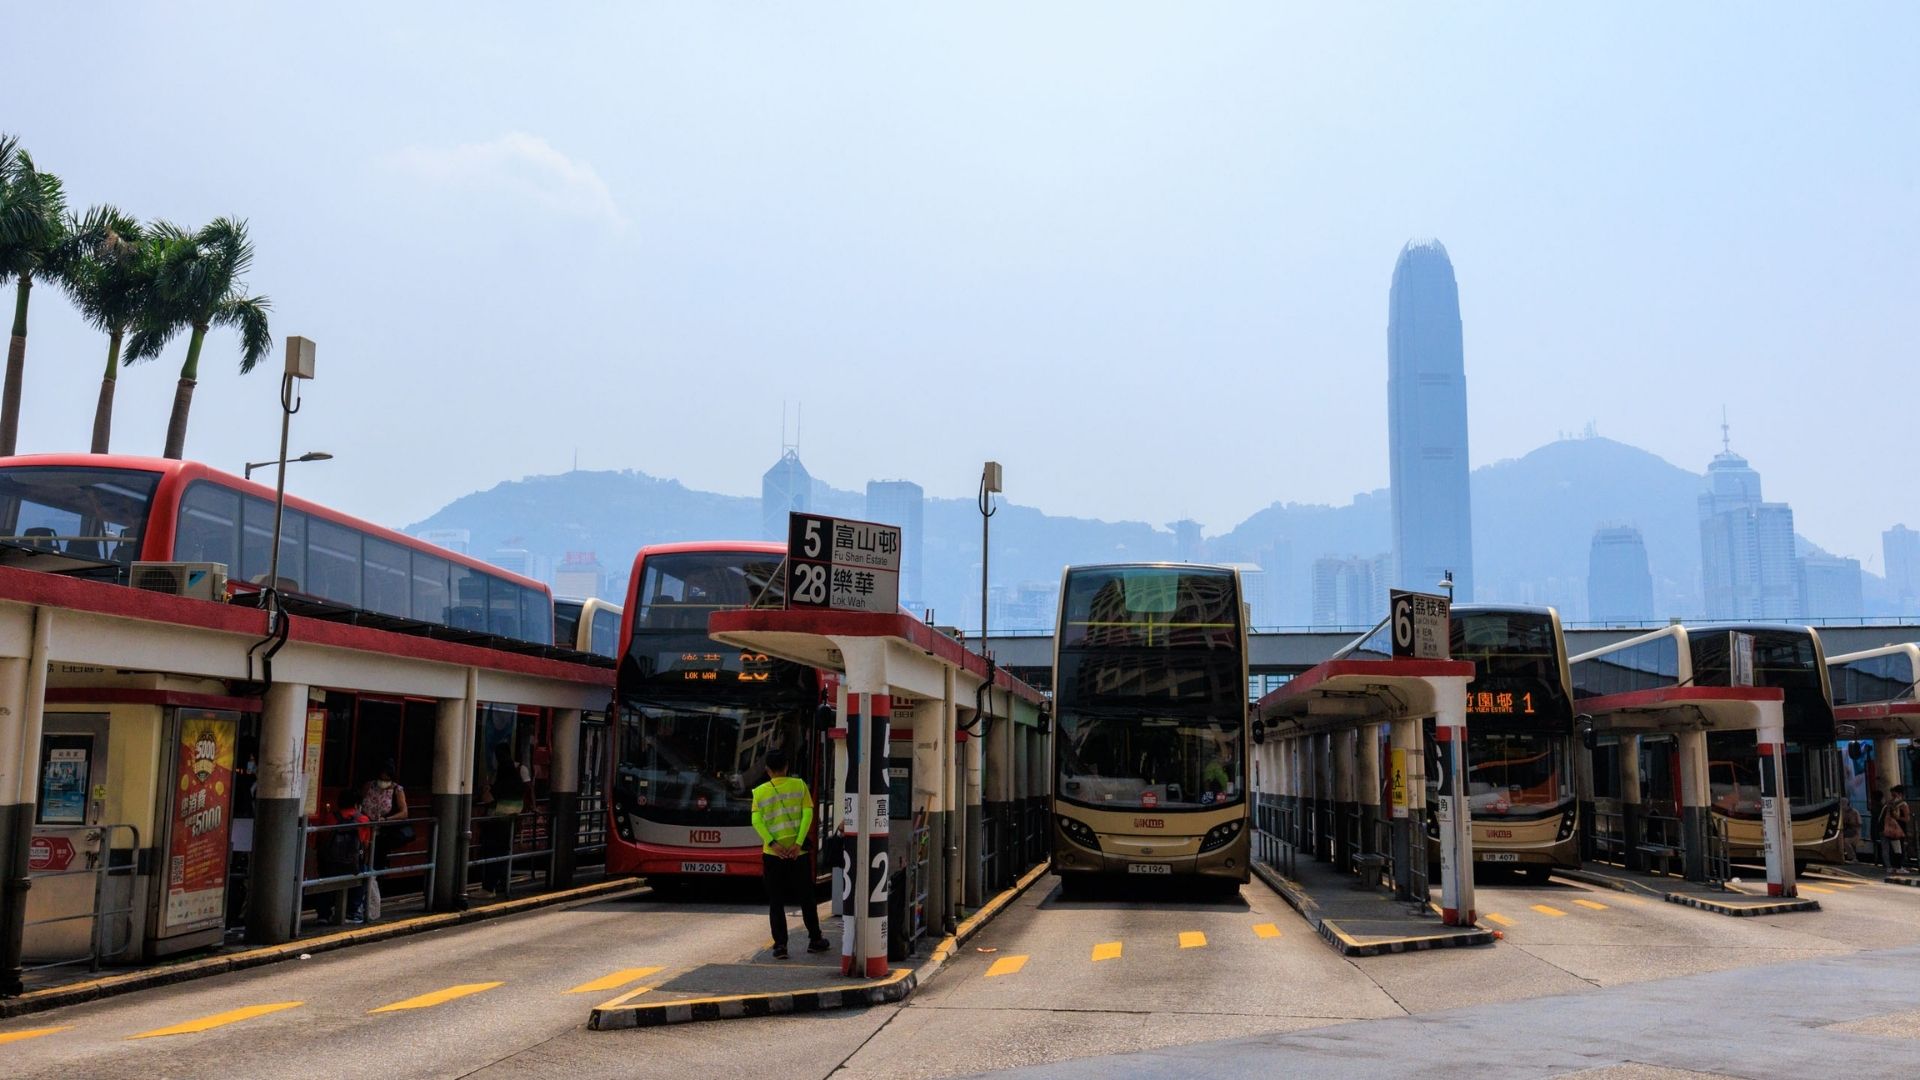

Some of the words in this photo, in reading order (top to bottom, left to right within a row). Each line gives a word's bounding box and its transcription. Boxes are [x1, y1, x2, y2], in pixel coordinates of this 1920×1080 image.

[804, 519, 822, 558] 5
[835, 524, 897, 554] 富山邨
[834, 550, 844, 561] Fu
[846, 552, 864, 564] Shan
[866, 554, 888, 566] Estate
[792, 563, 827, 604] 28
[832, 568, 875, 596] 樂華
[832, 595, 847, 606] Lok
[848, 597, 866, 608] Wah
[1415, 598, 1447, 618] 荔枝角
[1395, 600, 1412, 648] 6
[685, 672, 698, 680] LOK
[702, 672, 717, 680] WAH
[1523, 692, 1535, 713] 1
[689, 829, 722, 843] KMB
[684, 863, 696, 872] VN
[699, 863, 723, 872] 2063
[869, 851, 888, 903] 2
[1135, 865, 1147, 873] TC
[1149, 865, 1165, 873] 196
